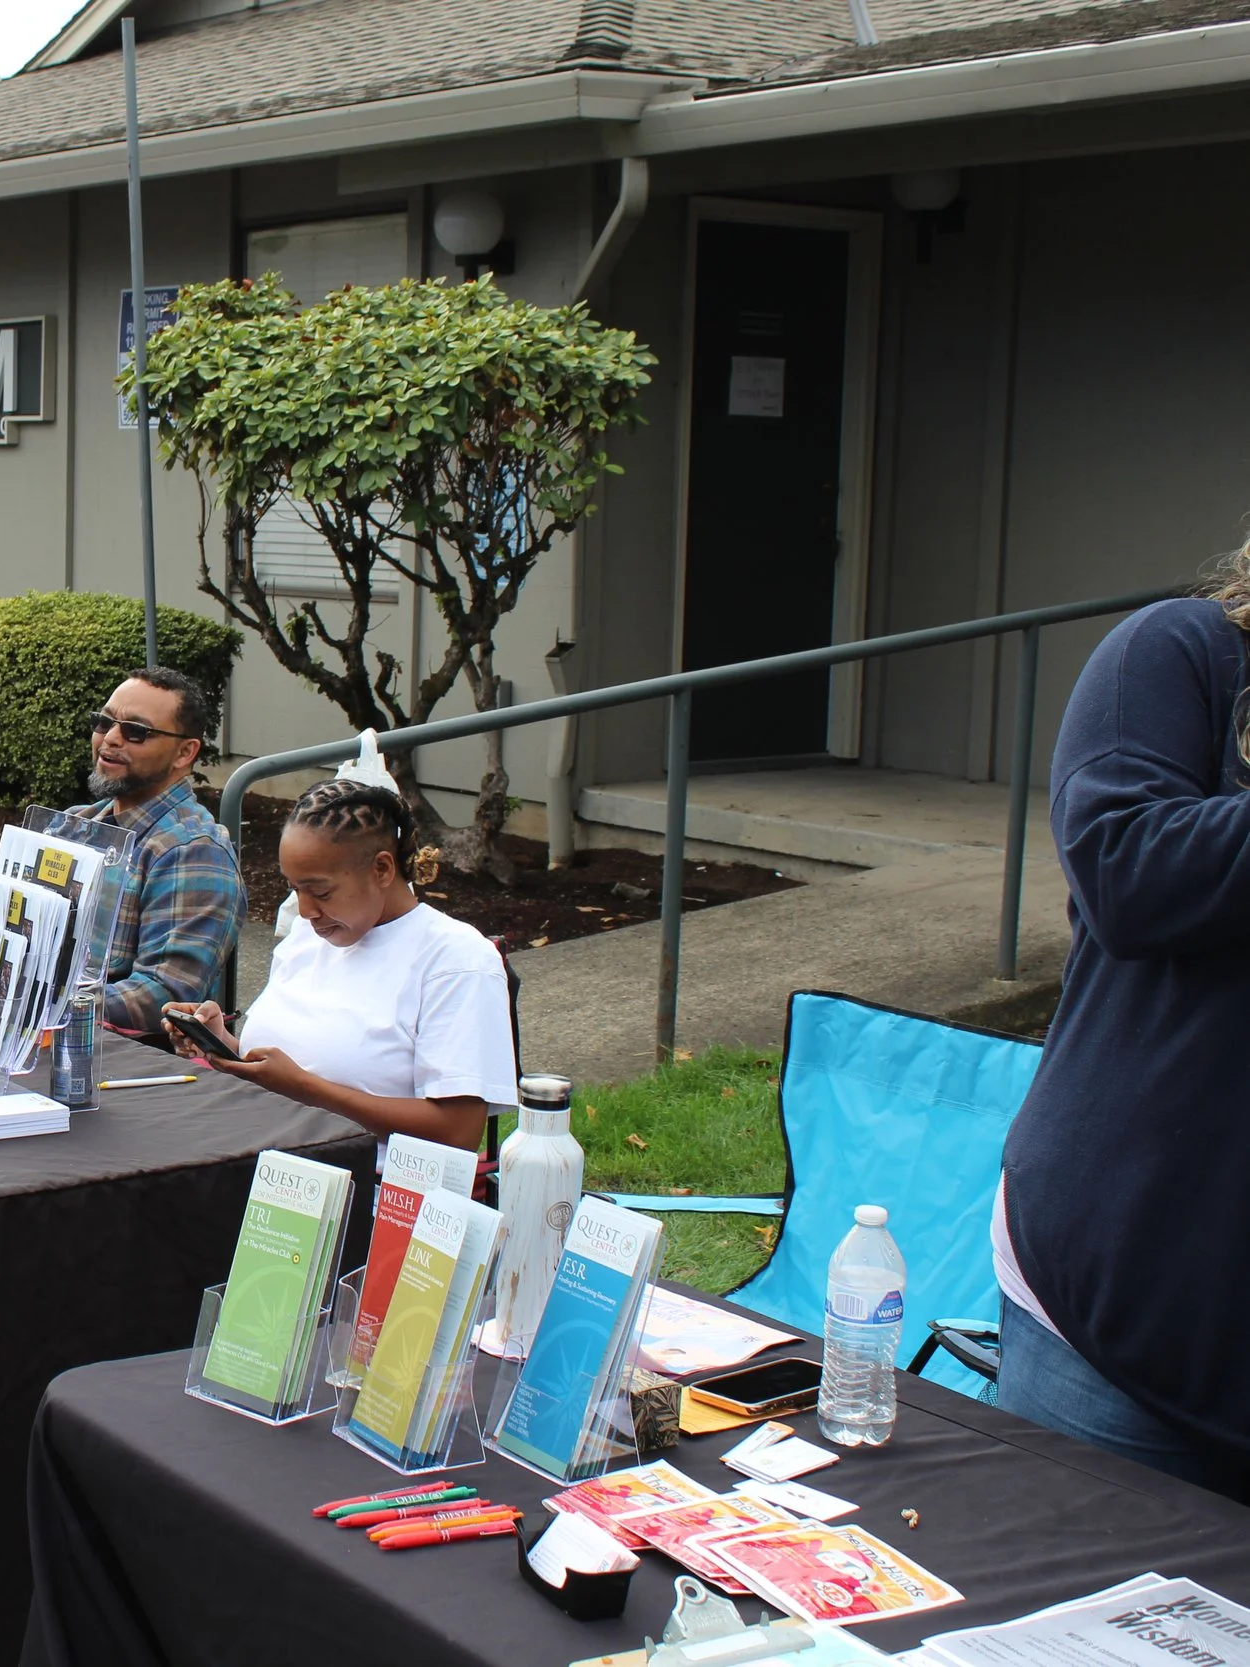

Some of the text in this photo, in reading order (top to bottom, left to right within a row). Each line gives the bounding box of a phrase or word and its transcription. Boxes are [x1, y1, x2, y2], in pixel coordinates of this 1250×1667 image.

[390, 1147, 425, 1172] QUEST
[258, 1164, 304, 1190] QUEST
[402, 1169, 426, 1183] CENTER
[274, 1185, 302, 1201] CENTER
[383, 1188, 415, 1213] W.I.S.H.
[250, 1204, 272, 1225] TRI
[422, 1202, 452, 1230] QUEST
[577, 1214, 621, 1244] QUEST
[408, 1244, 433, 1269] LINK
[590, 1239, 619, 1256] CENTER
[395, 1493, 427, 1505] QUEST
[433, 1509, 465, 1521] QUEST
